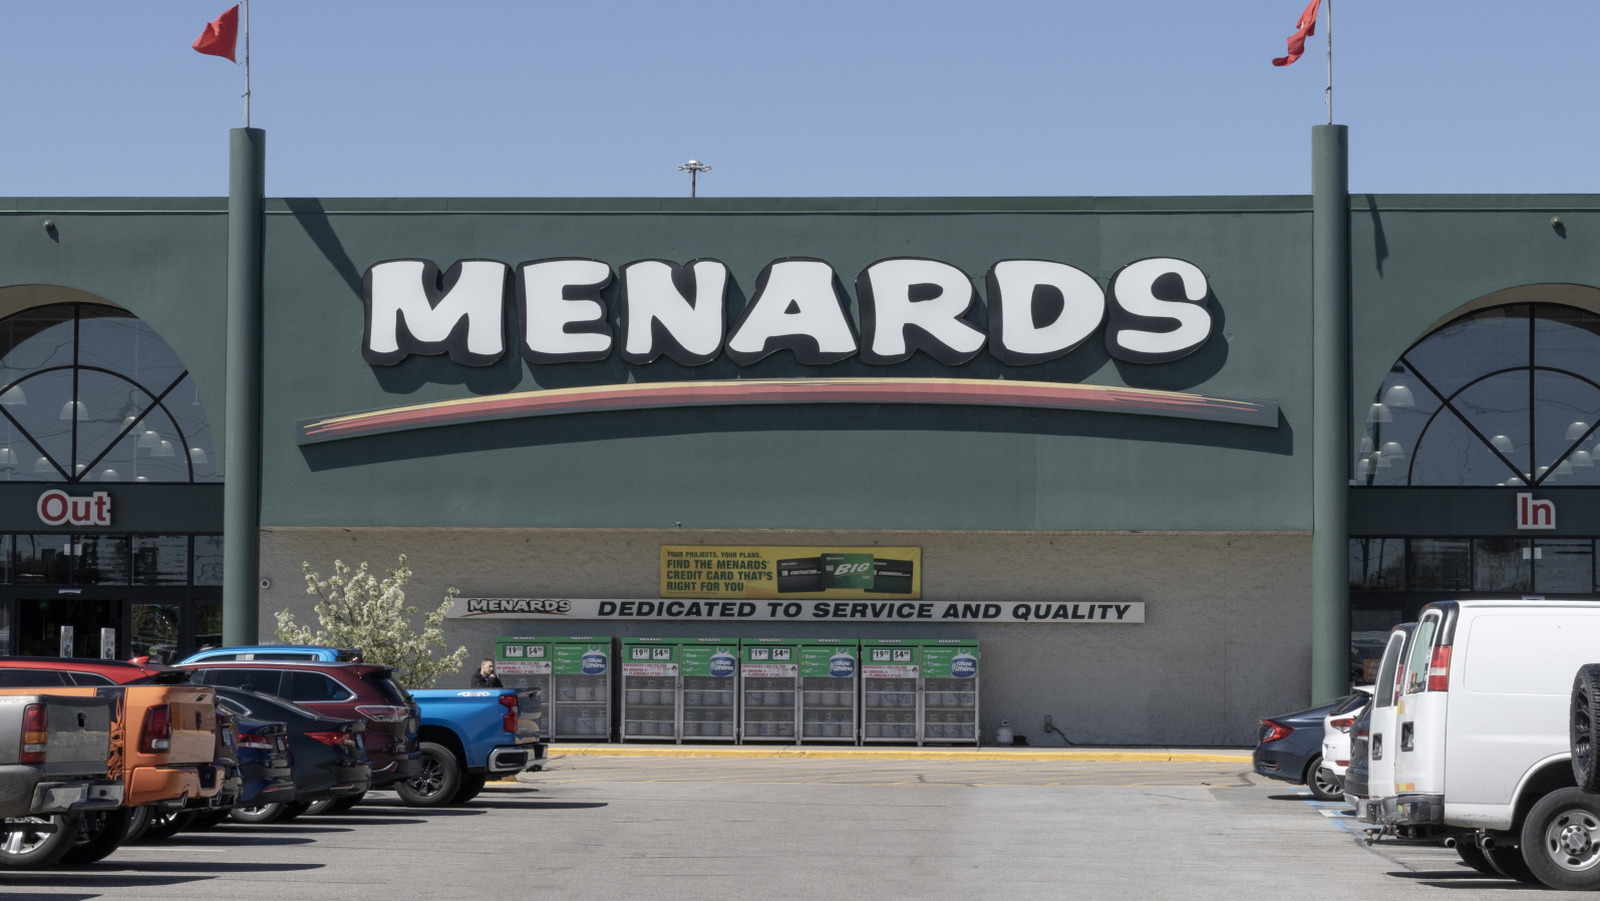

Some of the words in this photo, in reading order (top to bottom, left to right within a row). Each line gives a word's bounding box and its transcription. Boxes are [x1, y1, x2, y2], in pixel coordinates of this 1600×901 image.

[364, 257, 1212, 364] MENARDS
[39, 490, 110, 525] Out
[1519, 494, 1554, 528] In
[667, 559, 690, 569] FIND
[694, 560, 713, 569] THE
[834, 562, 871, 576] BIG
[667, 570, 703, 580] CREDIT
[706, 571, 734, 580] CARD
[738, 571, 773, 581] THAT'S
[667, 581, 697, 591] RIGHT
[700, 582, 720, 591] FOR
[724, 582, 744, 592] YOU
[467, 599, 572, 613] MENARDS
[597, 601, 757, 617] DEDICATED
[767, 602, 803, 618] TO
[812, 602, 935, 619] SERVICE
[941, 603, 1002, 619] AND
[1011, 604, 1132, 621] QUALITY
